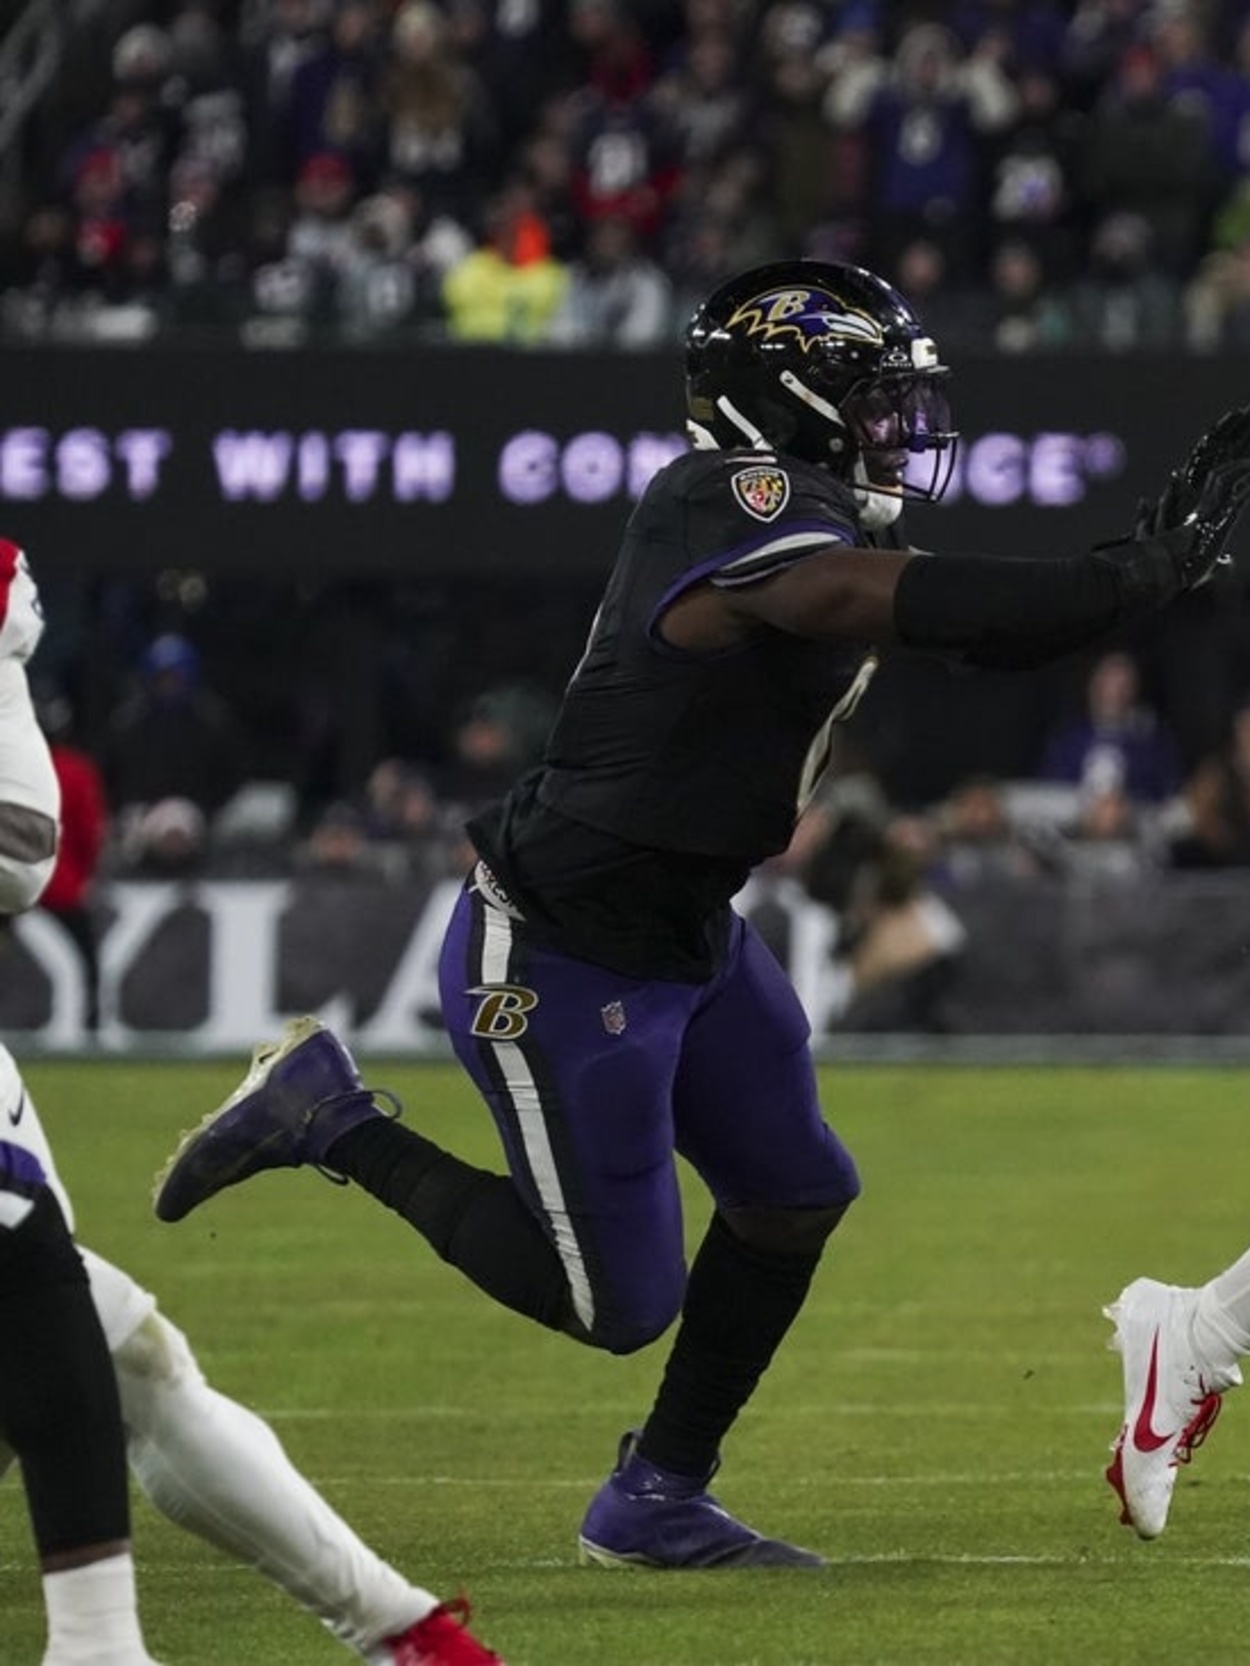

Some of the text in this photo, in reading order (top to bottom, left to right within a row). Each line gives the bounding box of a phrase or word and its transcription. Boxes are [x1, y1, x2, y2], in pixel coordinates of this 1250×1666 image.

[766, 290, 811, 321] B
[212, 430, 455, 504] WITH
[465, 983, 540, 1041] B
